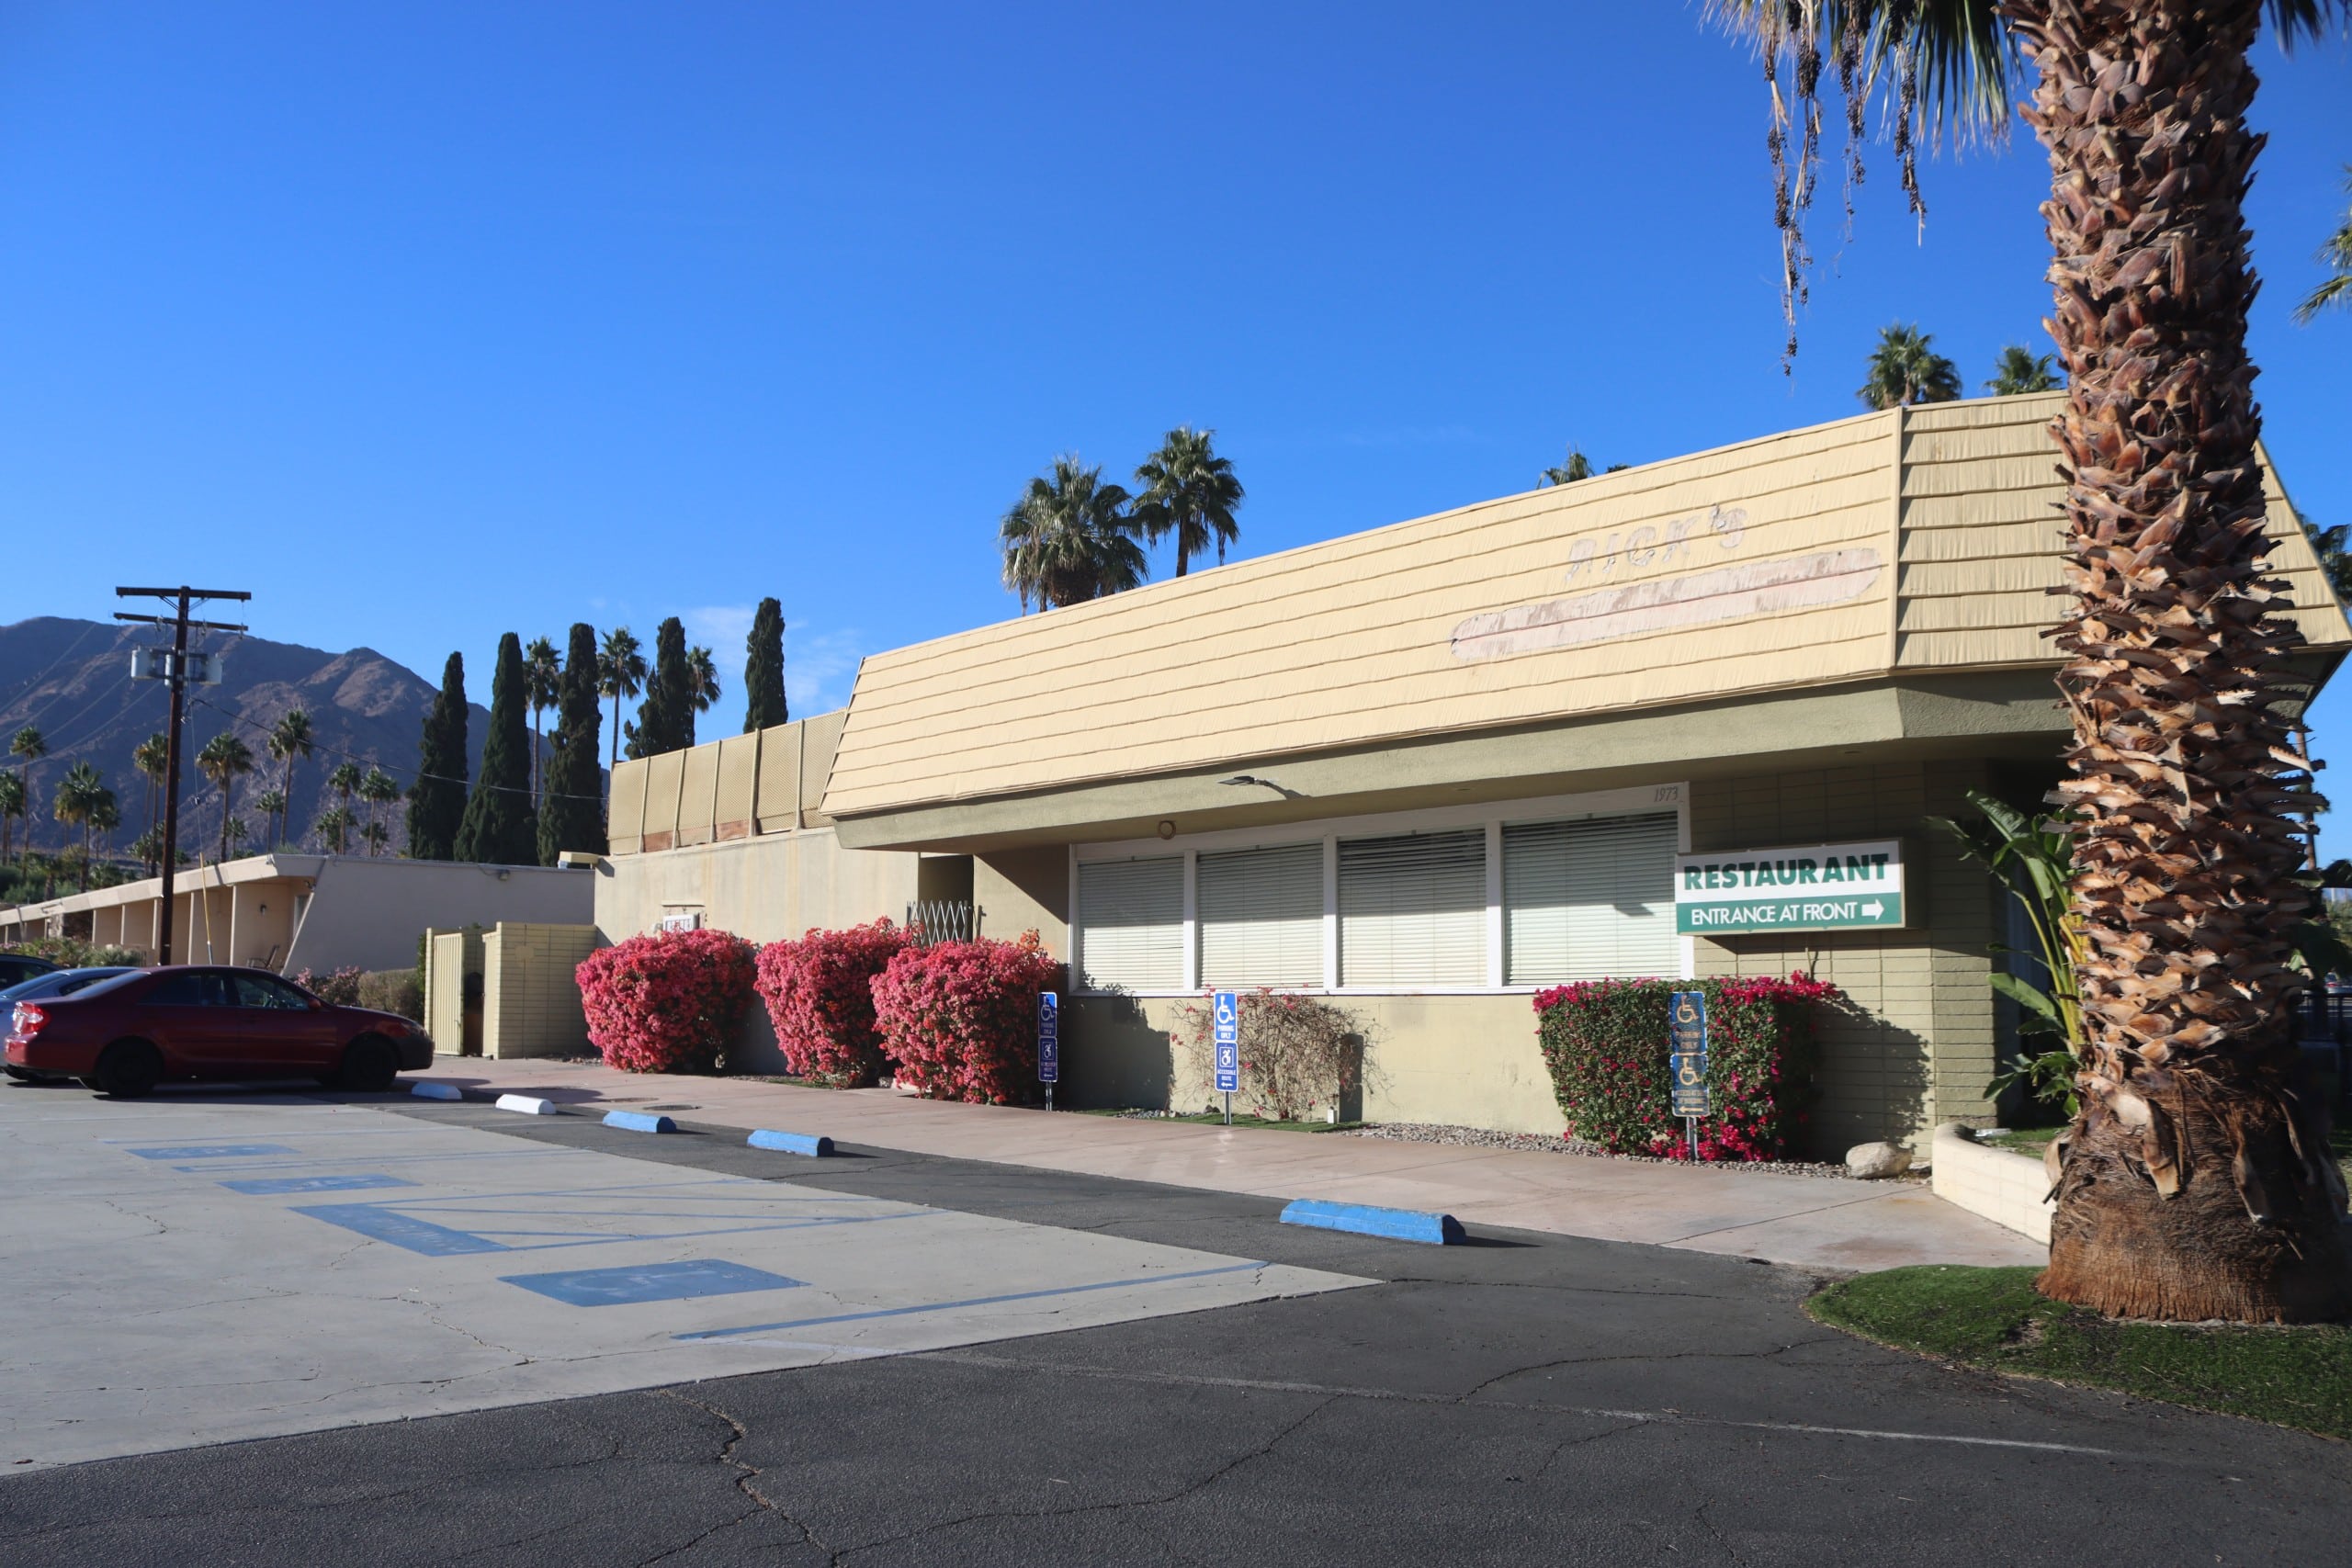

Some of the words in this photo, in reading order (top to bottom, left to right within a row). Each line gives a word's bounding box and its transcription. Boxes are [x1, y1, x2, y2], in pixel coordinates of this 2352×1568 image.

[1654, 786, 1679, 802] 1973
[1684, 853, 1889, 890] RESTAURANT
[1691, 905, 1776, 925] ENTRANCE
[1779, 905, 1801, 923] AT
[1803, 902, 1858, 920] FRONT
